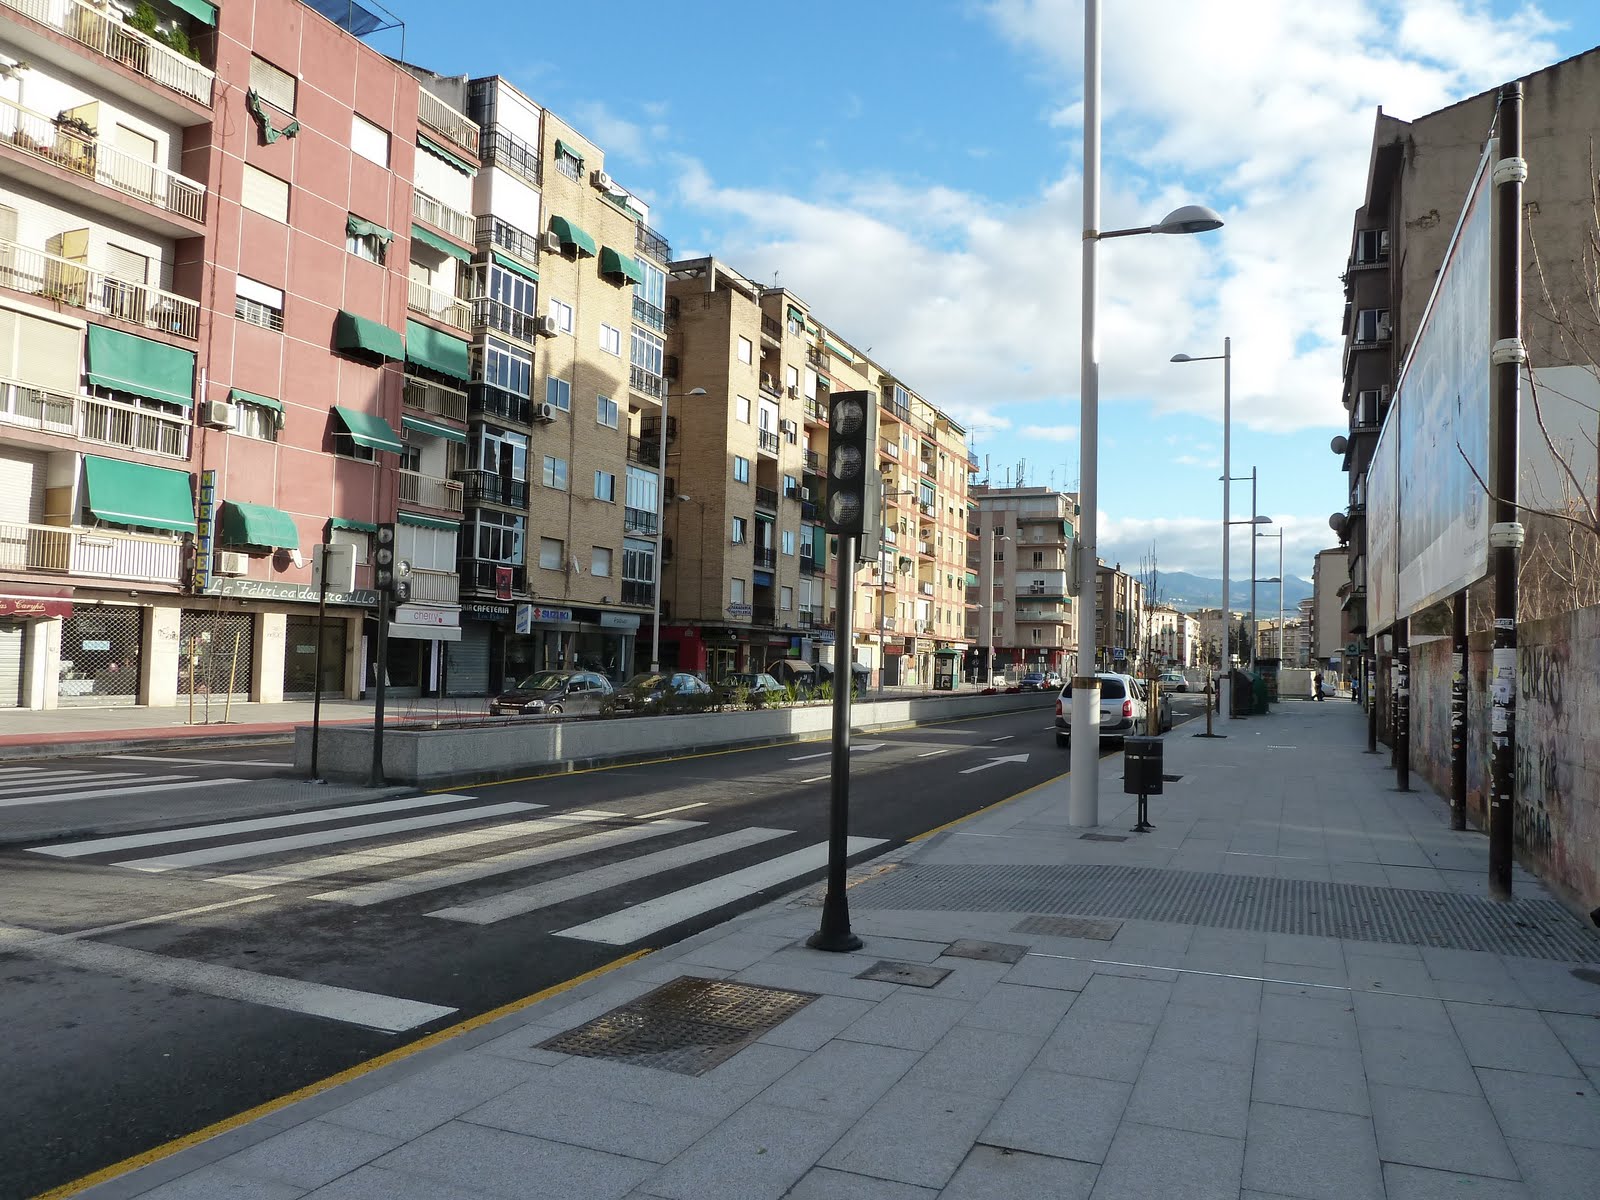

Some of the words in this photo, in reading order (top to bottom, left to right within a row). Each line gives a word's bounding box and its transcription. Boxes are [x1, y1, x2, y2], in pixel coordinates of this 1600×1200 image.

[196, 473, 212, 587] MUEBLES
[207, 579, 233, 595] La
[237, 581, 297, 599] Fábrica
[473, 604, 509, 614] CAFETERIA
[414, 612, 438, 621] cherry
[541, 610, 569, 619] SUZUKI
